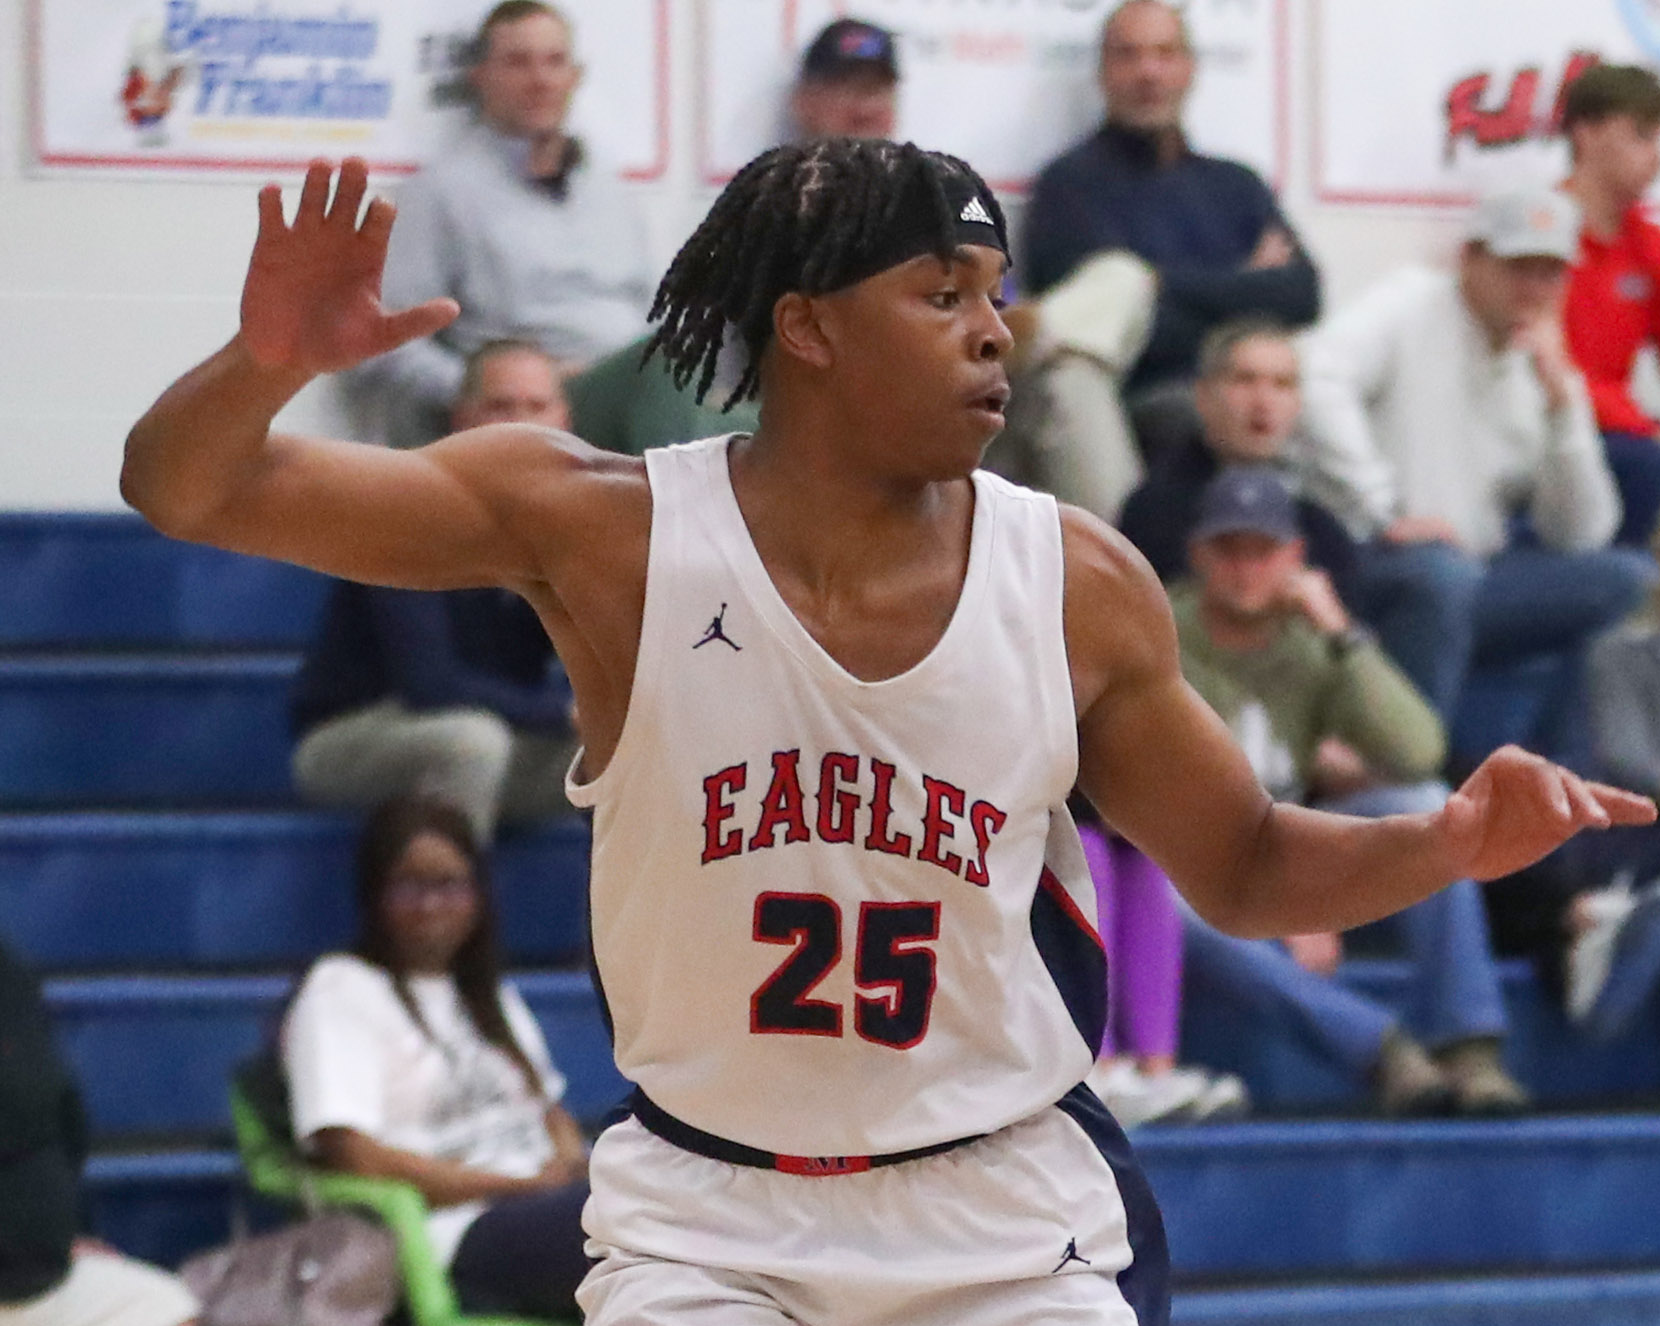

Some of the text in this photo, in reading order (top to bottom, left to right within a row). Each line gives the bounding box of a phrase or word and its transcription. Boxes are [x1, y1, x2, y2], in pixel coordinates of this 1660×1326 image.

[196, 62, 391, 118] Franklin
[701, 749, 1007, 887] EAGLES
[750, 891, 941, 1050] 25
